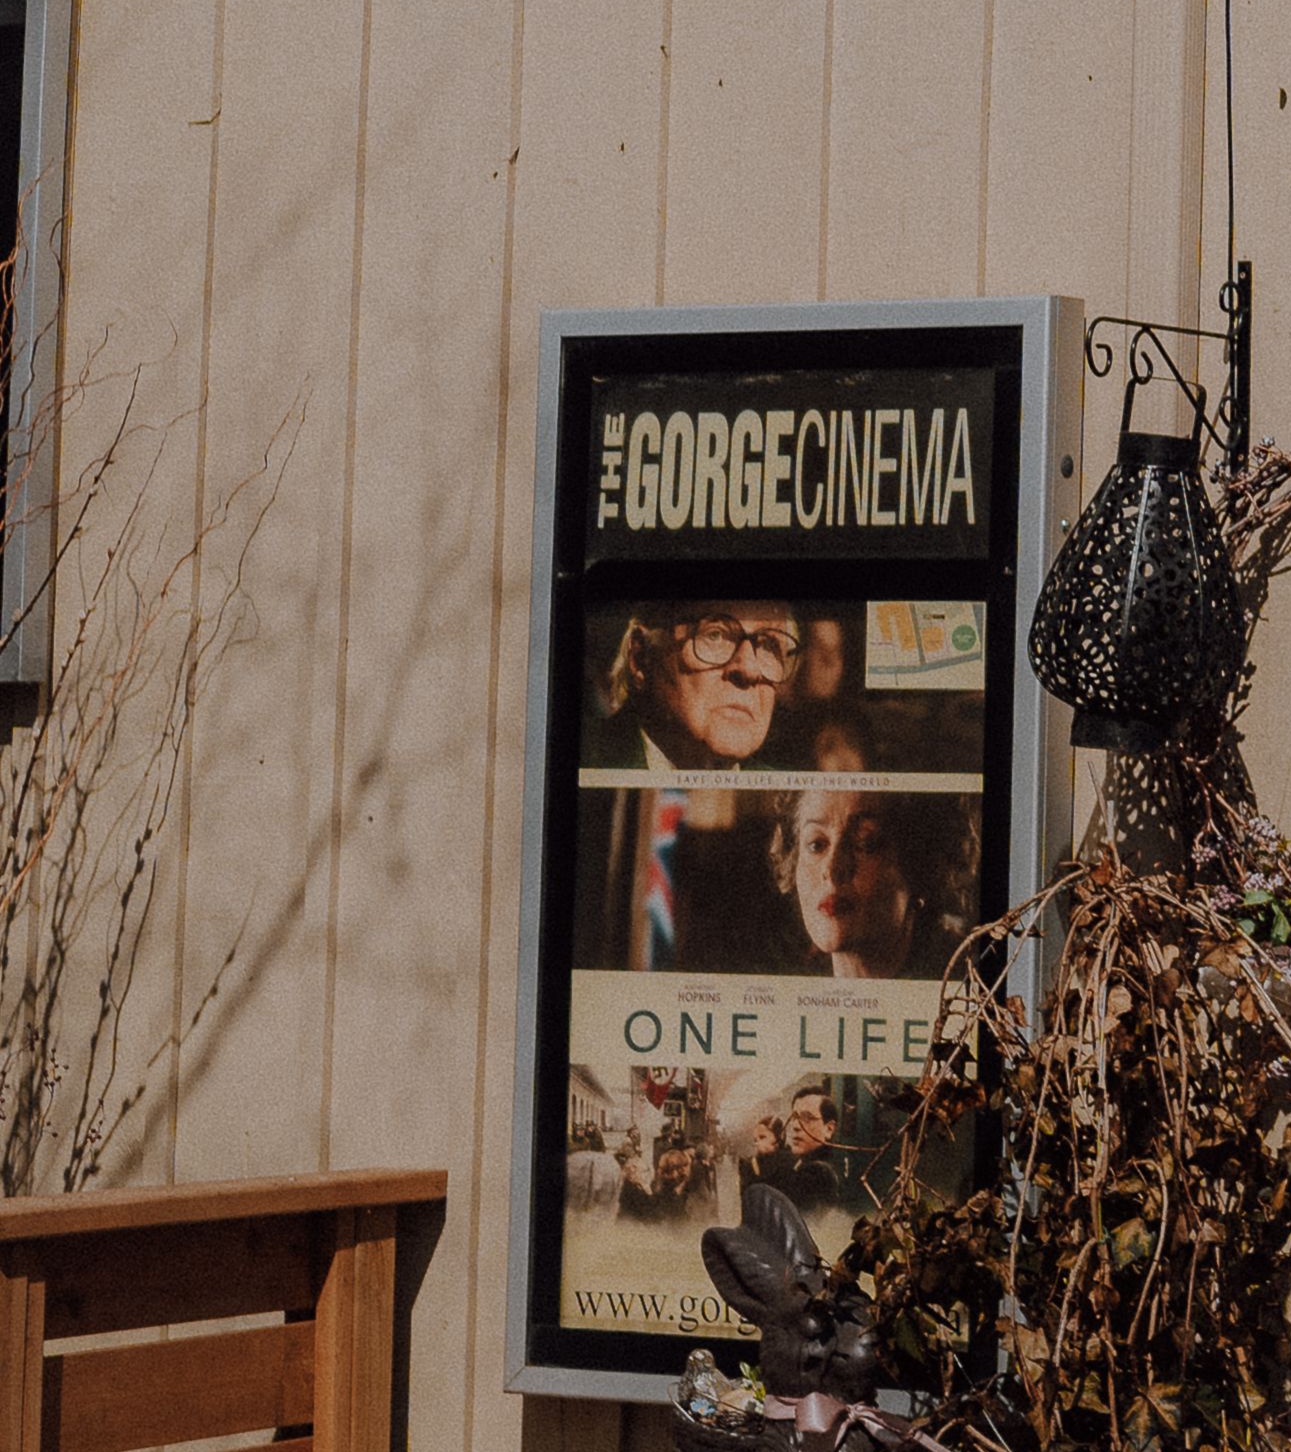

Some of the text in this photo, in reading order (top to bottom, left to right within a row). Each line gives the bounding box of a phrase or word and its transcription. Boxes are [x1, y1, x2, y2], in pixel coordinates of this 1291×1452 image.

[597, 411, 626, 530] THE
[678, 991, 879, 1009] HOPKINS FLYNN BONHAM CARTER
[624, 1010, 930, 1063] ONE LIFE
